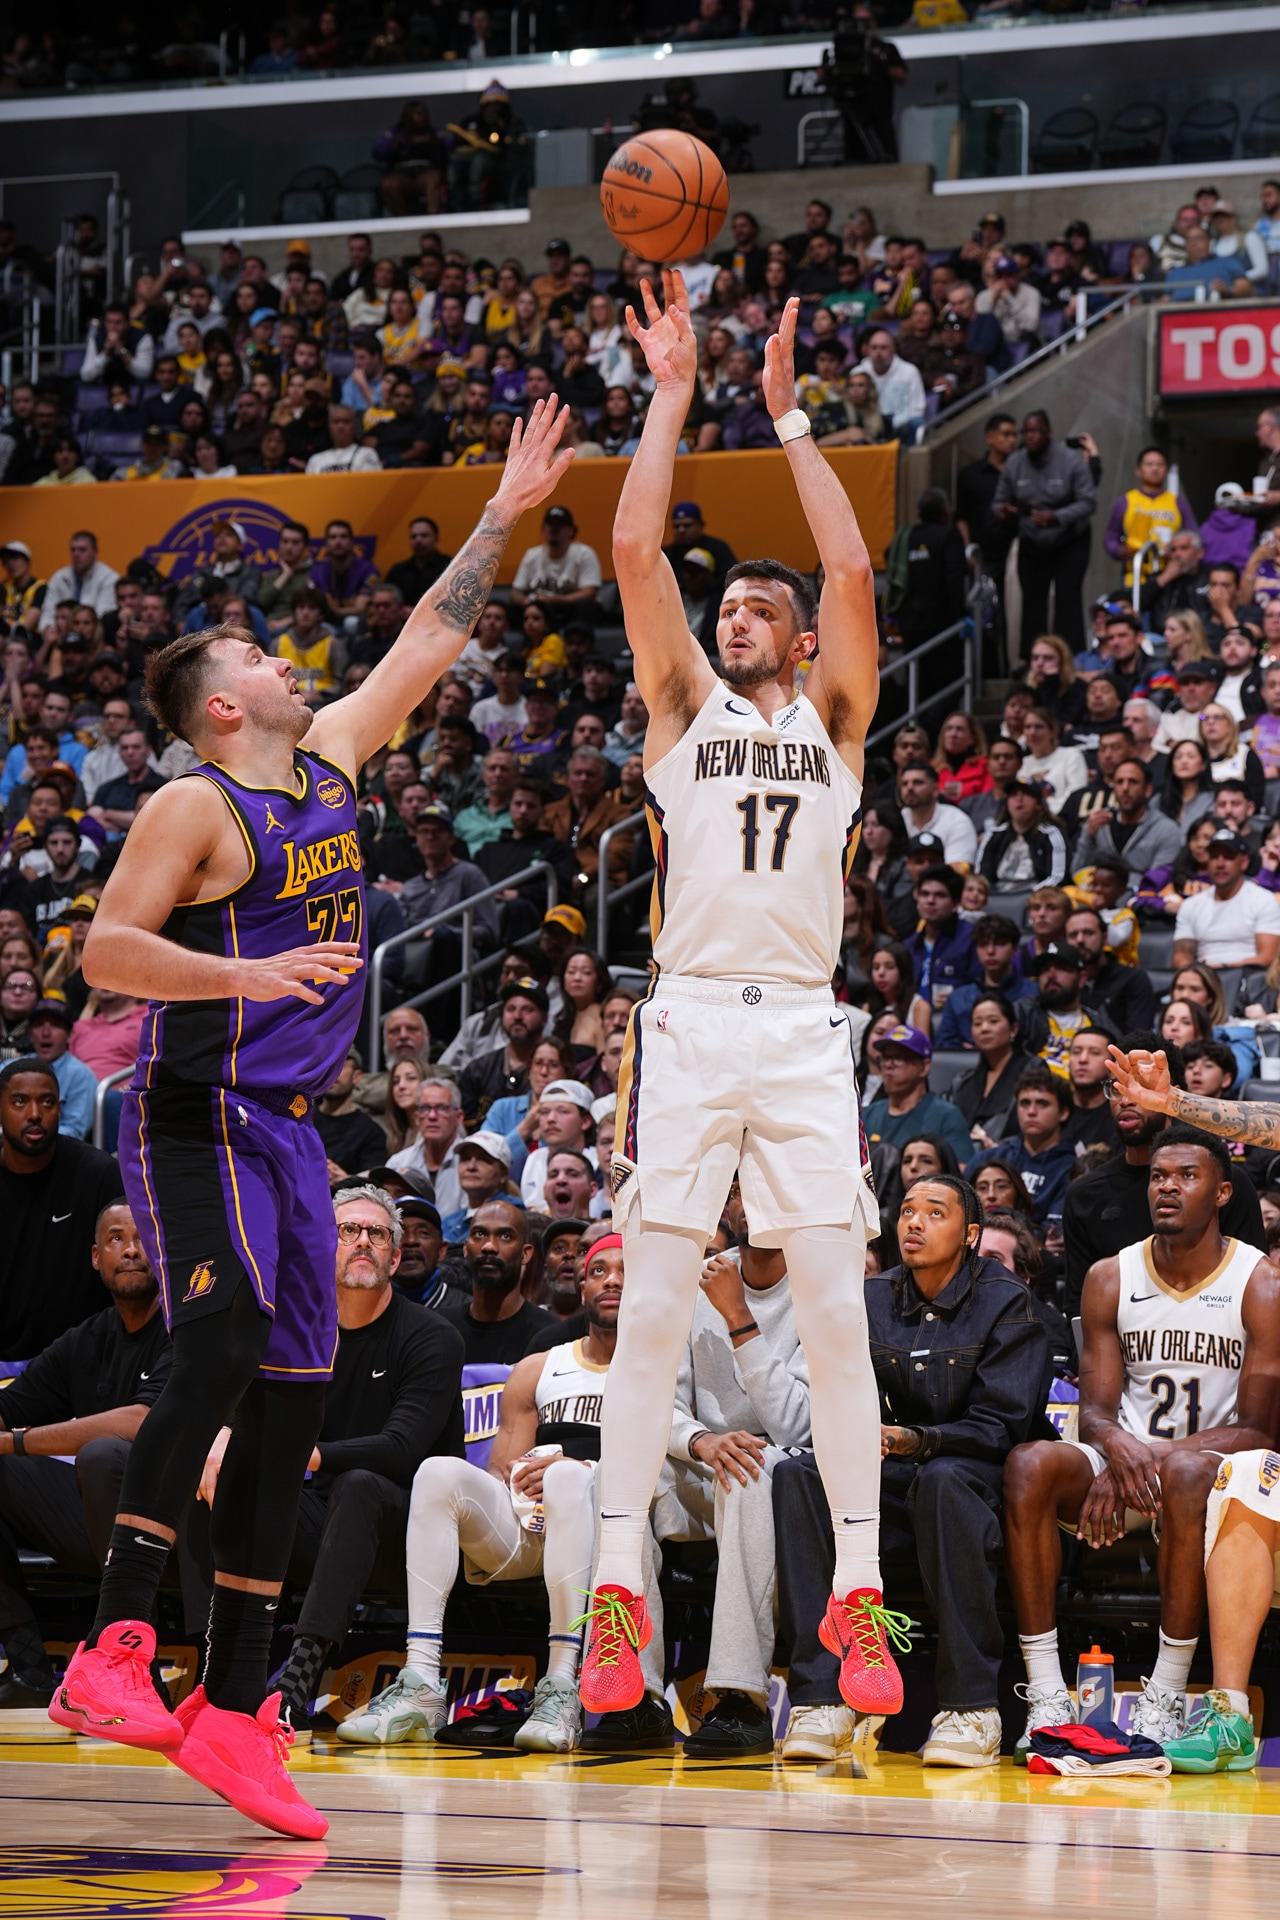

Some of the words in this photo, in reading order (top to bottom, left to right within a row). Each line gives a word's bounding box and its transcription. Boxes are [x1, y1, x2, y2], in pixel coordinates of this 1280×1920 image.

[1170, 322, 1280, 381] TO
[777, 703, 800, 726] WAGE
[695, 738, 749, 782] NEW
[752, 741, 831, 788] ORLEANS
[320, 786, 343, 801] bibigo
[736, 793, 801, 873] 17
[275, 829, 361, 900] LAKERS
[306, 886, 362, 985] 77
[1199, 1294, 1232, 1303] NEWAGE
[1161, 1329, 1242, 1370] ORLEANS
[573, 1395, 603, 1423] ORL
[1148, 1374, 1202, 1440] 21
[861, 1714, 872, 1746] HYDRAT
